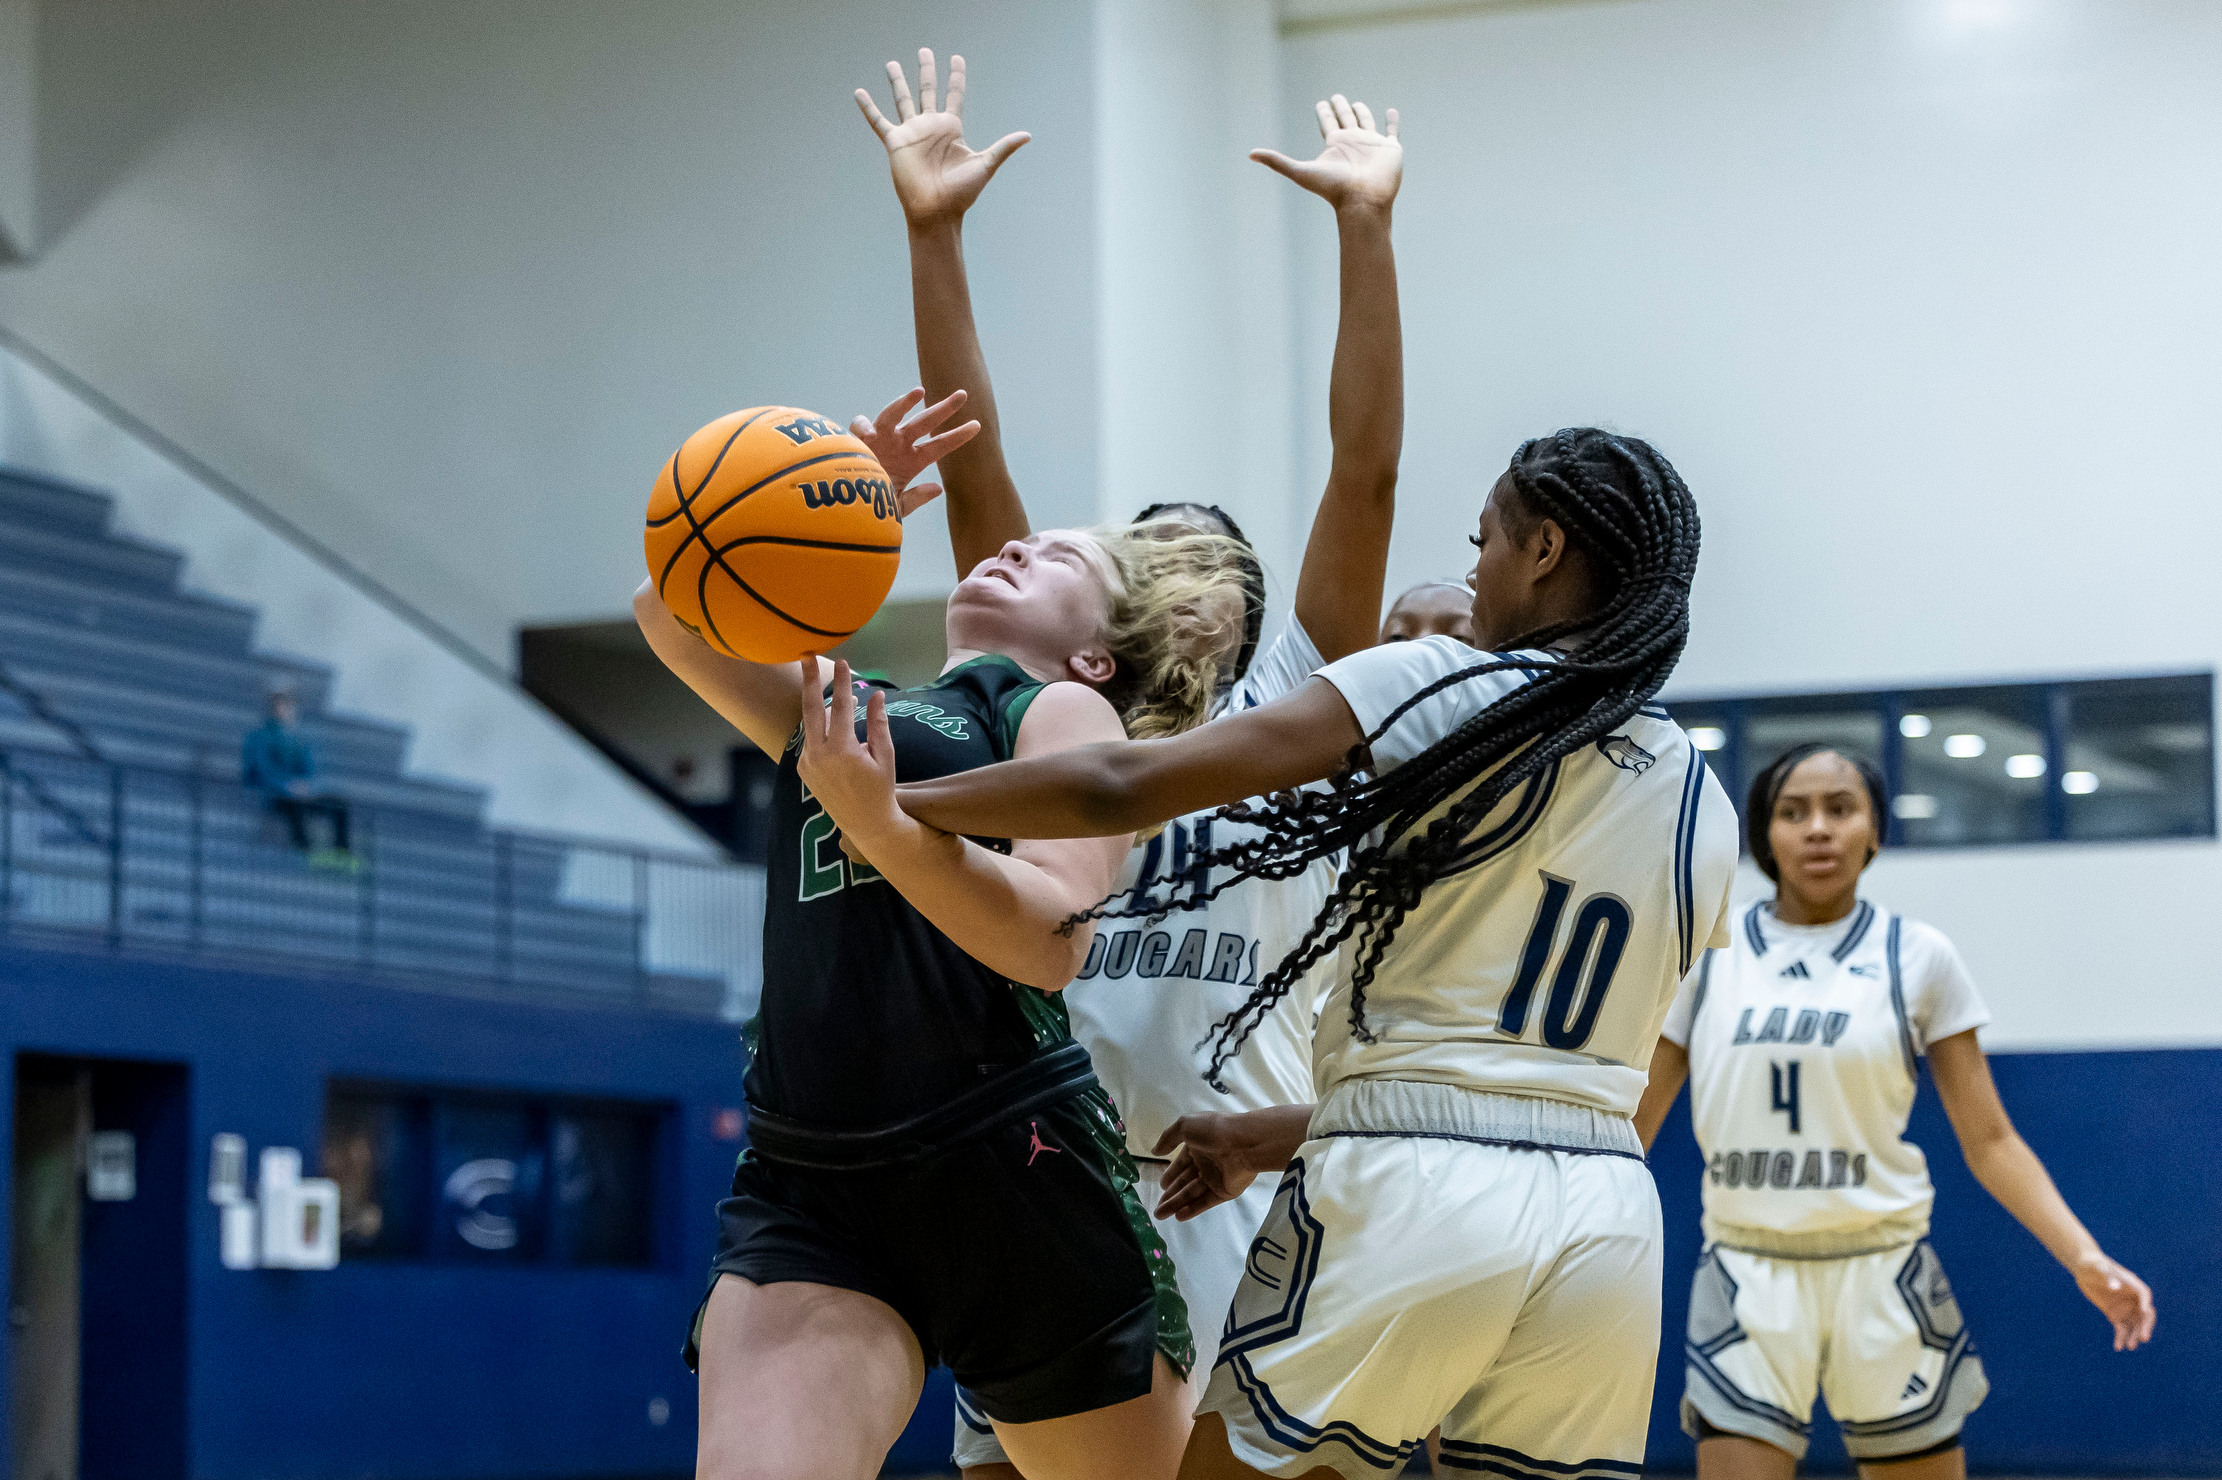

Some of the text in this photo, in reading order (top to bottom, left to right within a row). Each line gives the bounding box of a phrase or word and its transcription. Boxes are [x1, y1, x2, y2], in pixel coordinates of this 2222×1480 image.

[1124, 815, 1214, 914] 24
[1077, 928, 1261, 987] OUGAR
[1493, 868, 1635, 1052] 10
[1732, 1006, 1851, 1048] LADY
[1769, 1059, 1802, 1135] 4
